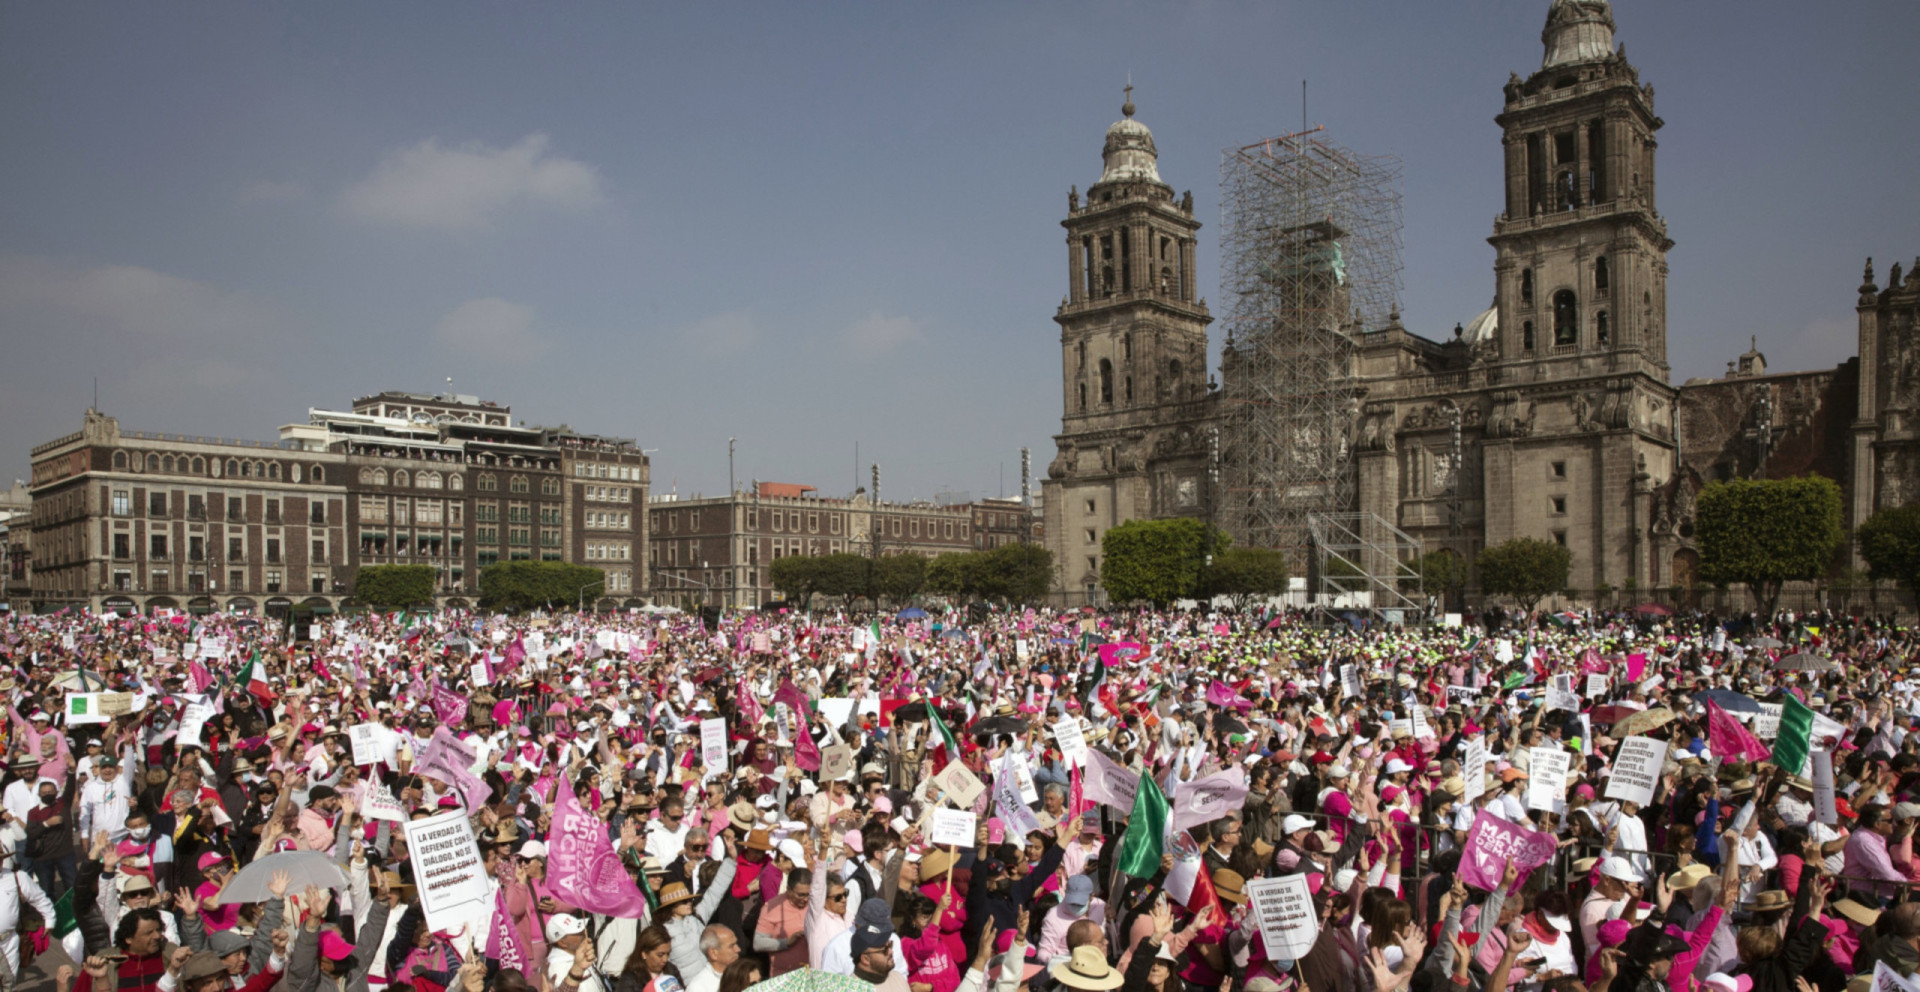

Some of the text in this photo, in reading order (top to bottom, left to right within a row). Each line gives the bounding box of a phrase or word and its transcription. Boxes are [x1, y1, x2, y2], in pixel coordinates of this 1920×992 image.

[417, 823, 463, 843] LA VERDAD SE
[1481, 819, 1551, 854] MARCHA
[420, 840, 454, 855] DEFIENDE
[454, 836, 466, 846] CON
[455, 849, 465, 858] NO
[464, 845, 472, 855] SE
[425, 863, 457, 878] SILENCIA
[457, 860, 471, 871] CON
[497, 913, 523, 971] ARCHA
